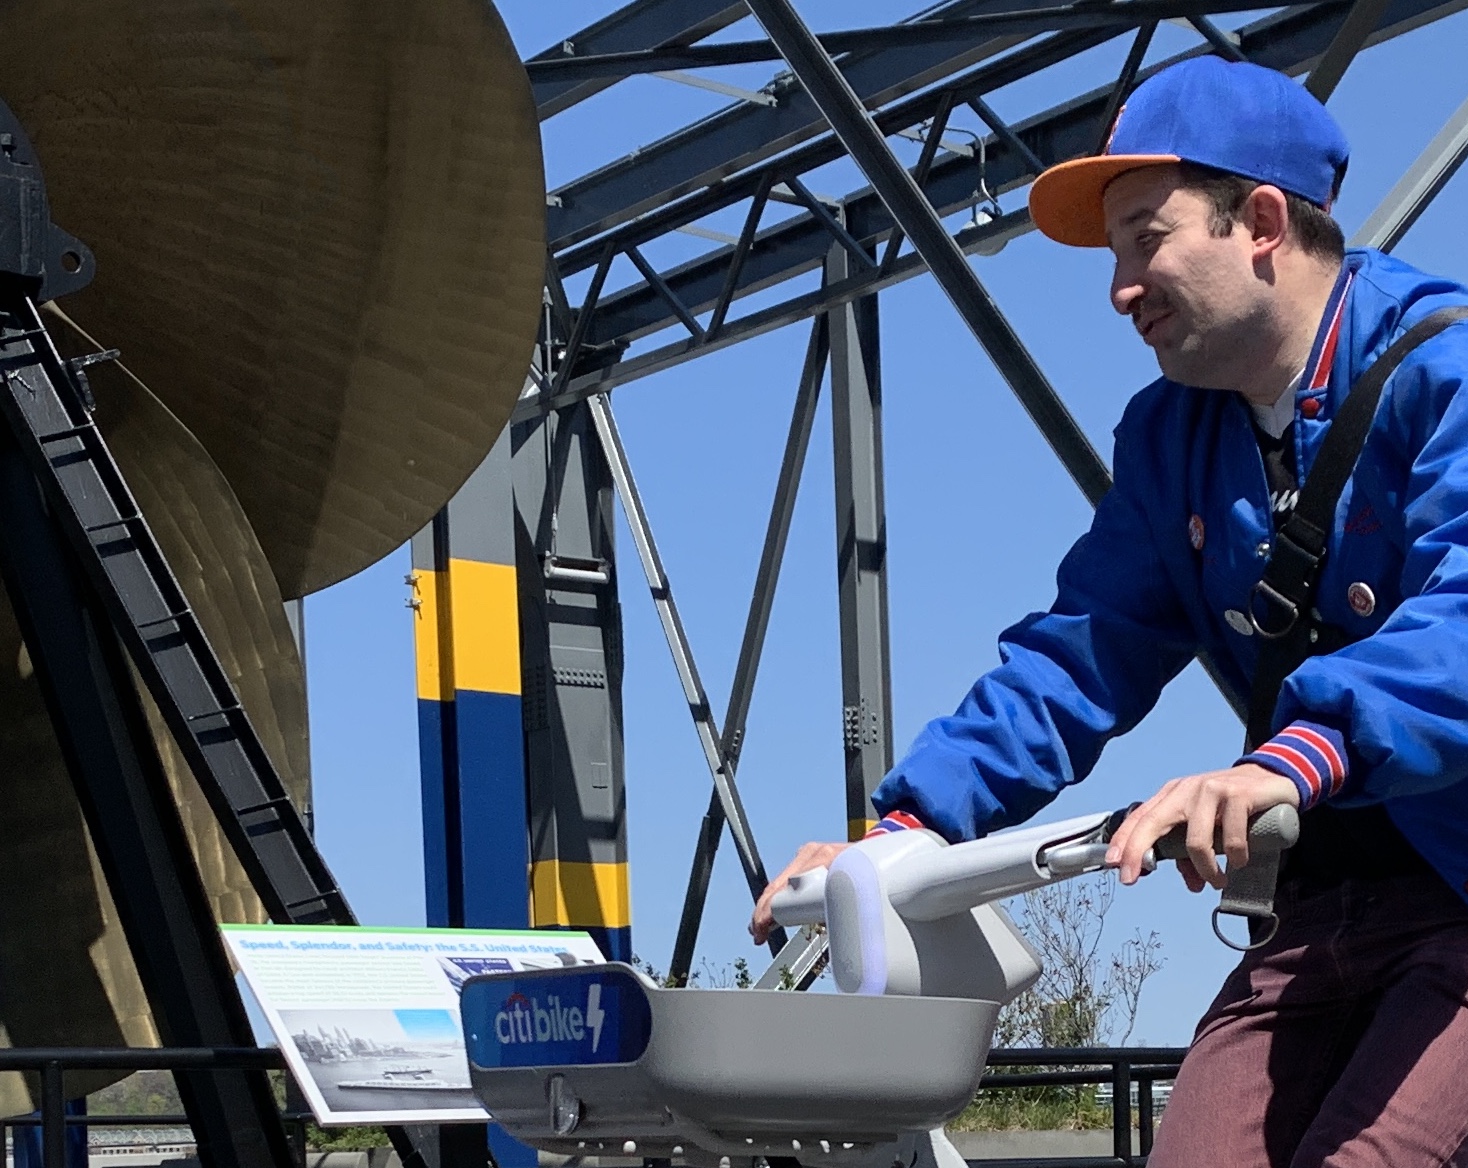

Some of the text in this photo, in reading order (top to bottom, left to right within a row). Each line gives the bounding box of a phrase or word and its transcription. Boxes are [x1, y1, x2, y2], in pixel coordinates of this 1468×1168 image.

[239, 940, 567, 954] Speed, Splendor, and Safety: the S.S. United States
[531, 994, 585, 1042] bike
